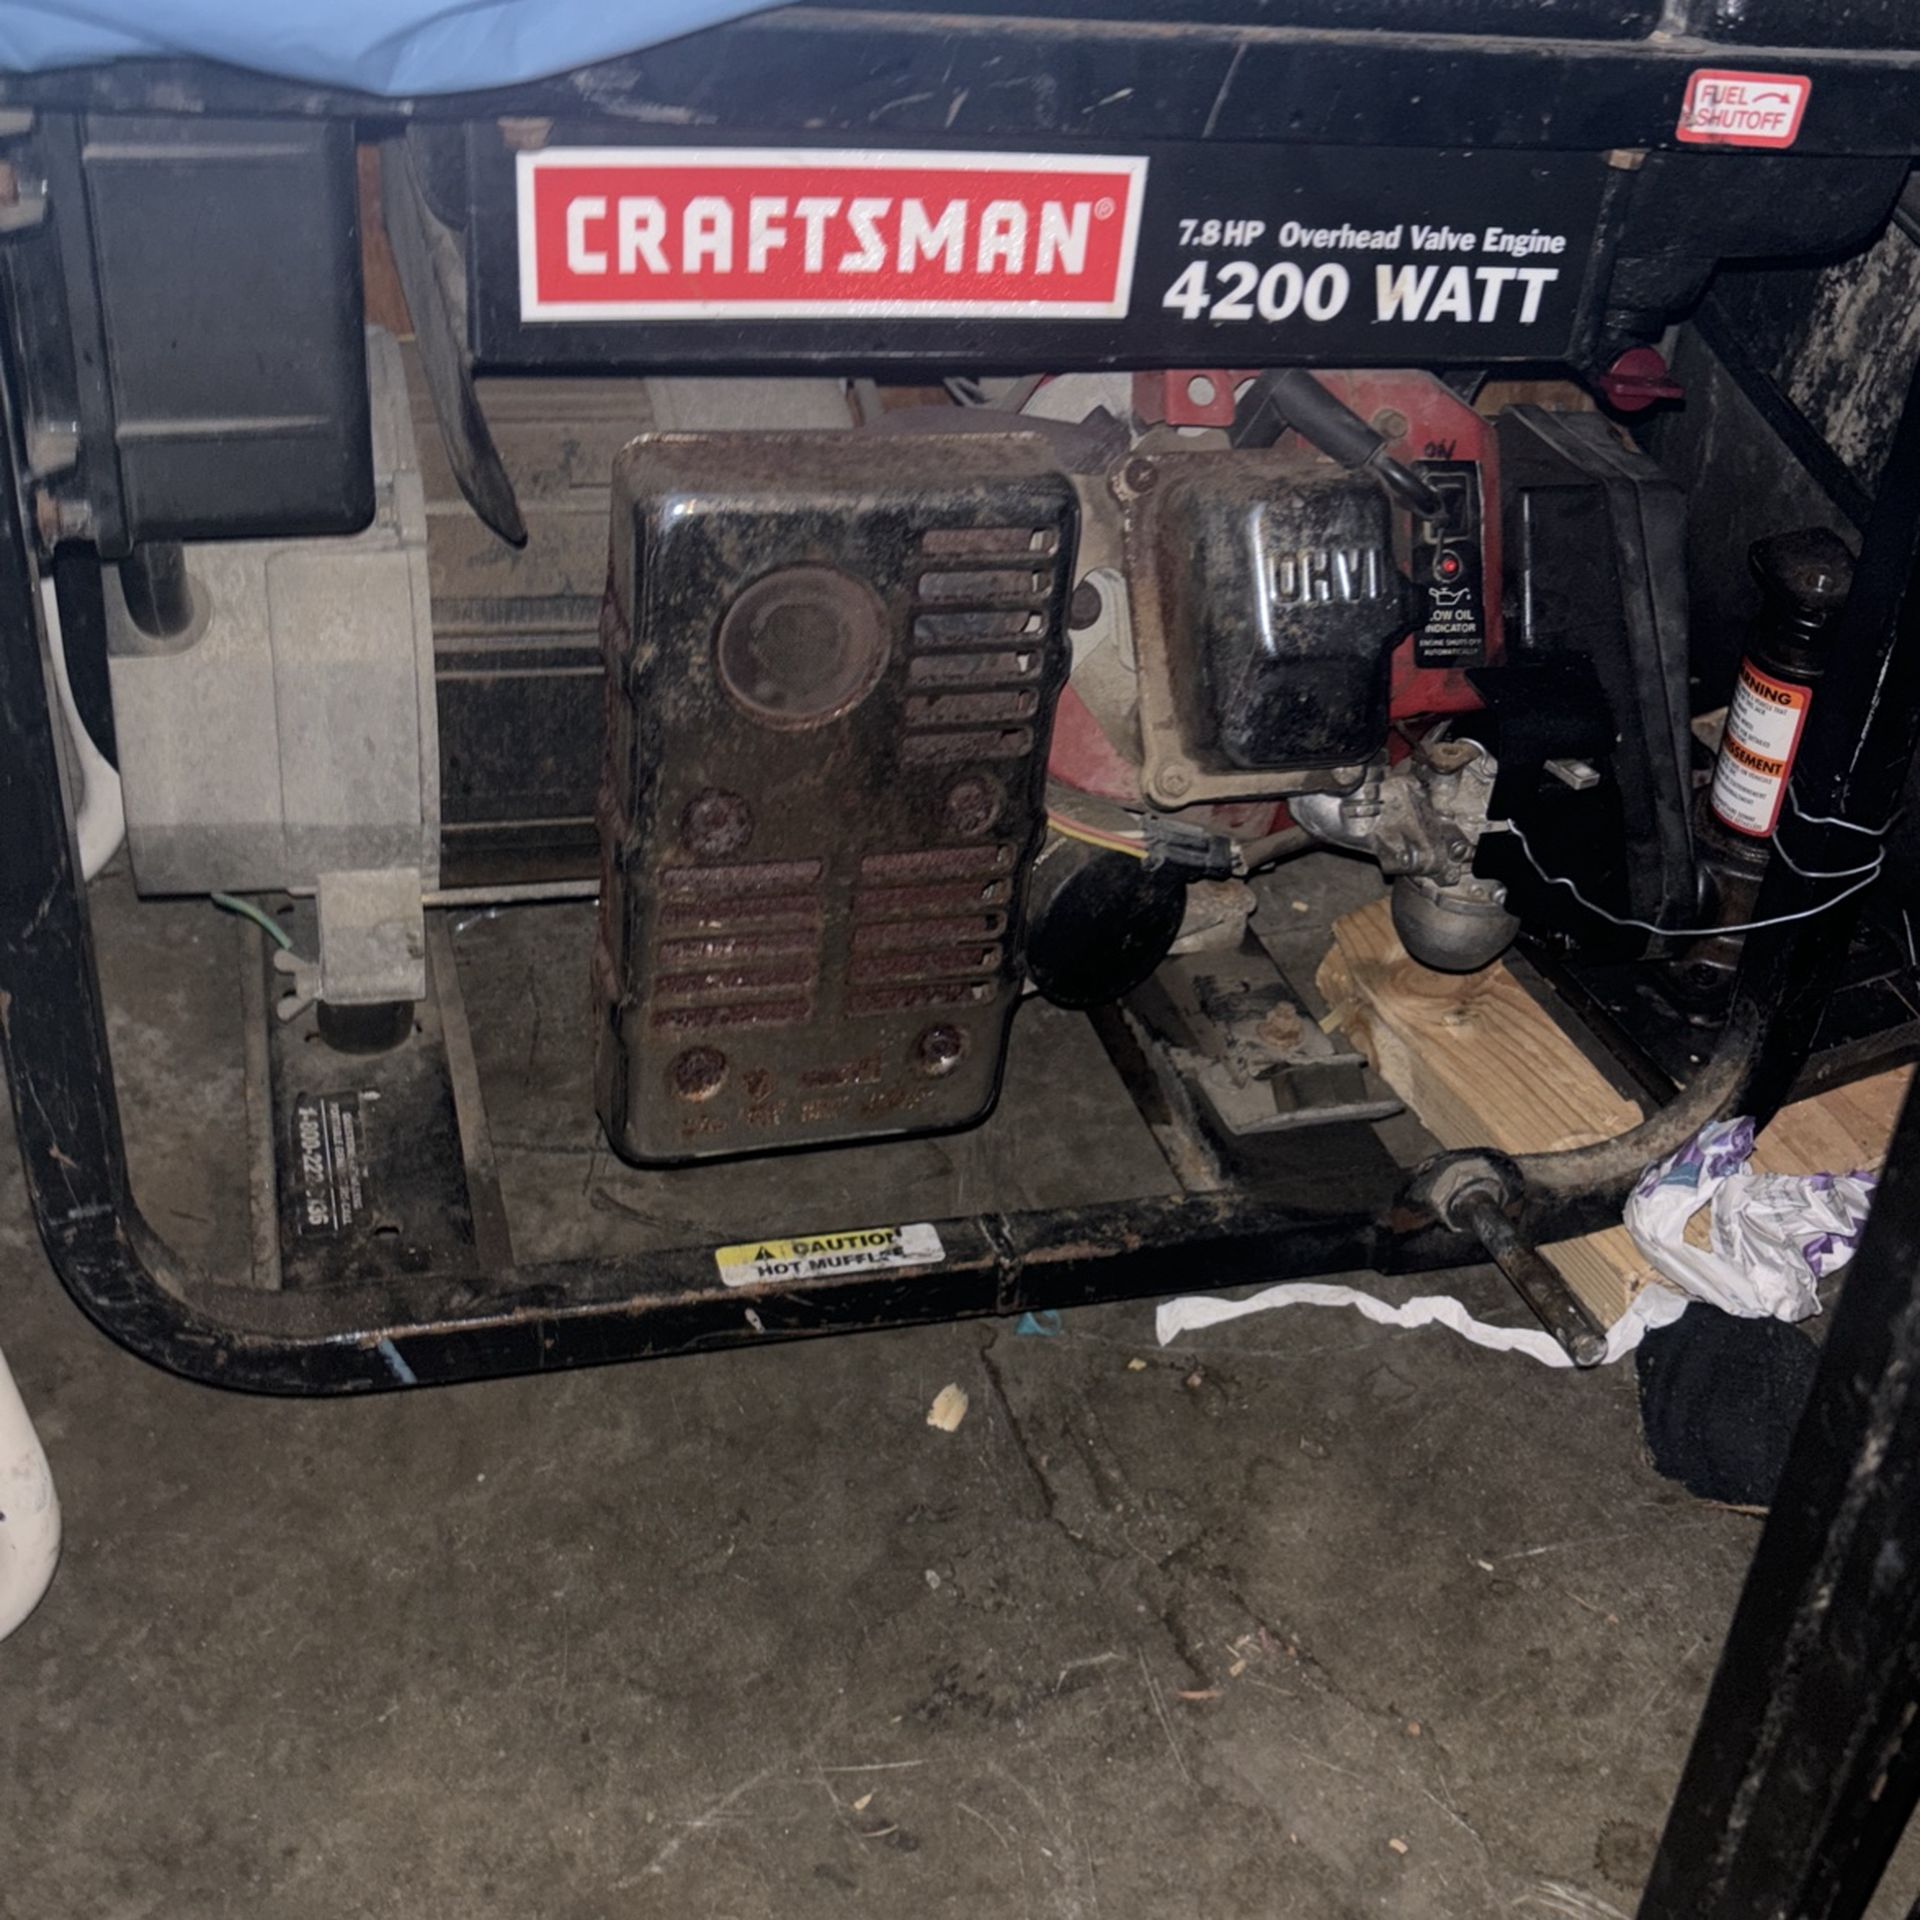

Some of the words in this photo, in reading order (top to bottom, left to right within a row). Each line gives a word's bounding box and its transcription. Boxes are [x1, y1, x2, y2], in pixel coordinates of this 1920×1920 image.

[1700, 84, 1748, 106] FUEL
[1695, 108, 1786, 131] SHUTOFF
[566, 195, 1092, 275] CRAFTSMAN
[1278, 221, 1403, 250] Overhead
[1410, 225, 1476, 252] Valve
[1482, 227, 1567, 257] Engine
[1162, 260, 1350, 322] 4200
[1375, 263, 1559, 323] WATT
[1424, 440, 1456, 458] ON
[1455, 609, 1475, 621] OIL
[1425, 623, 1476, 633] INDICATOR
[1741, 668, 1792, 705] ARNING
[757, 1262, 801, 1278] HOT
